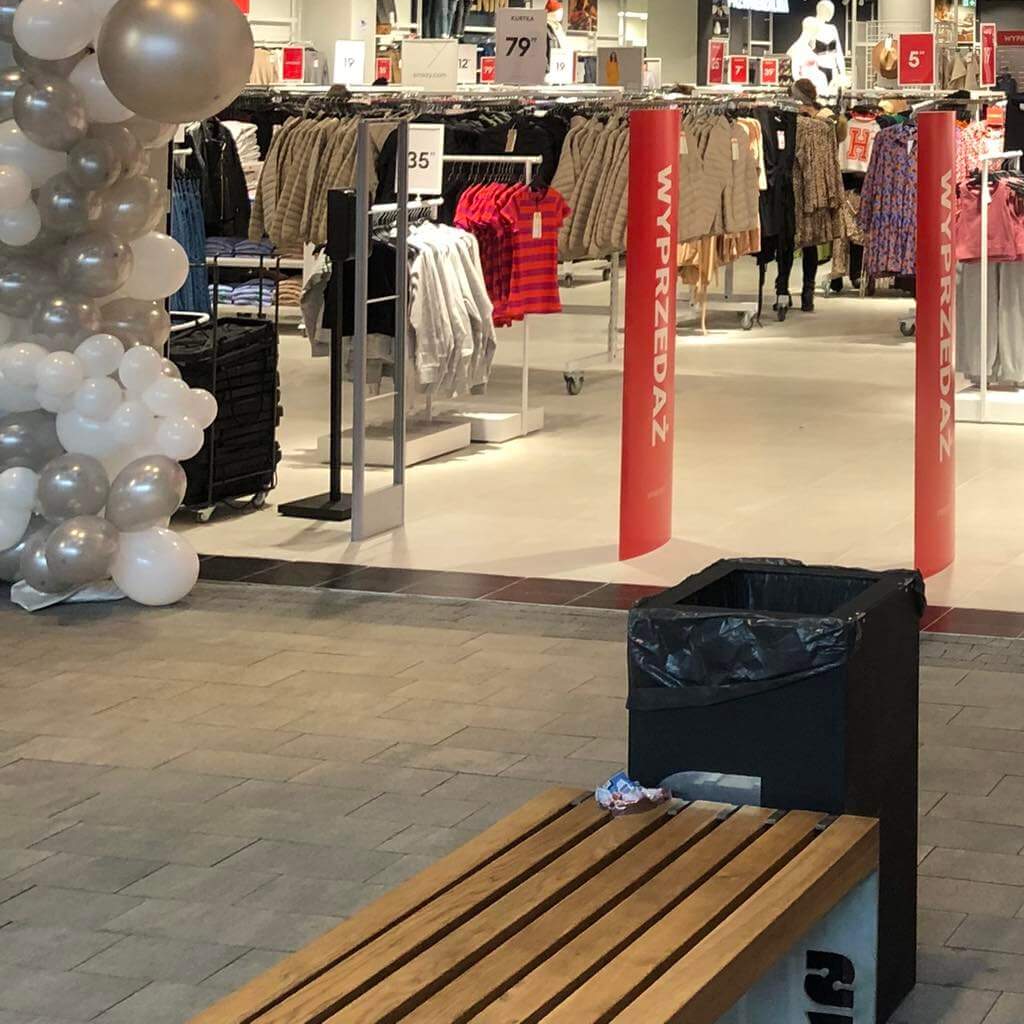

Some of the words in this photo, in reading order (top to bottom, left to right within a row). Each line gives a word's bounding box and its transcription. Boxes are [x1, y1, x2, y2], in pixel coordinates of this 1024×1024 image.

[506, 37, 531, 56] 79
[848, 128, 871, 161] H
[408, 151, 429, 169] 35
